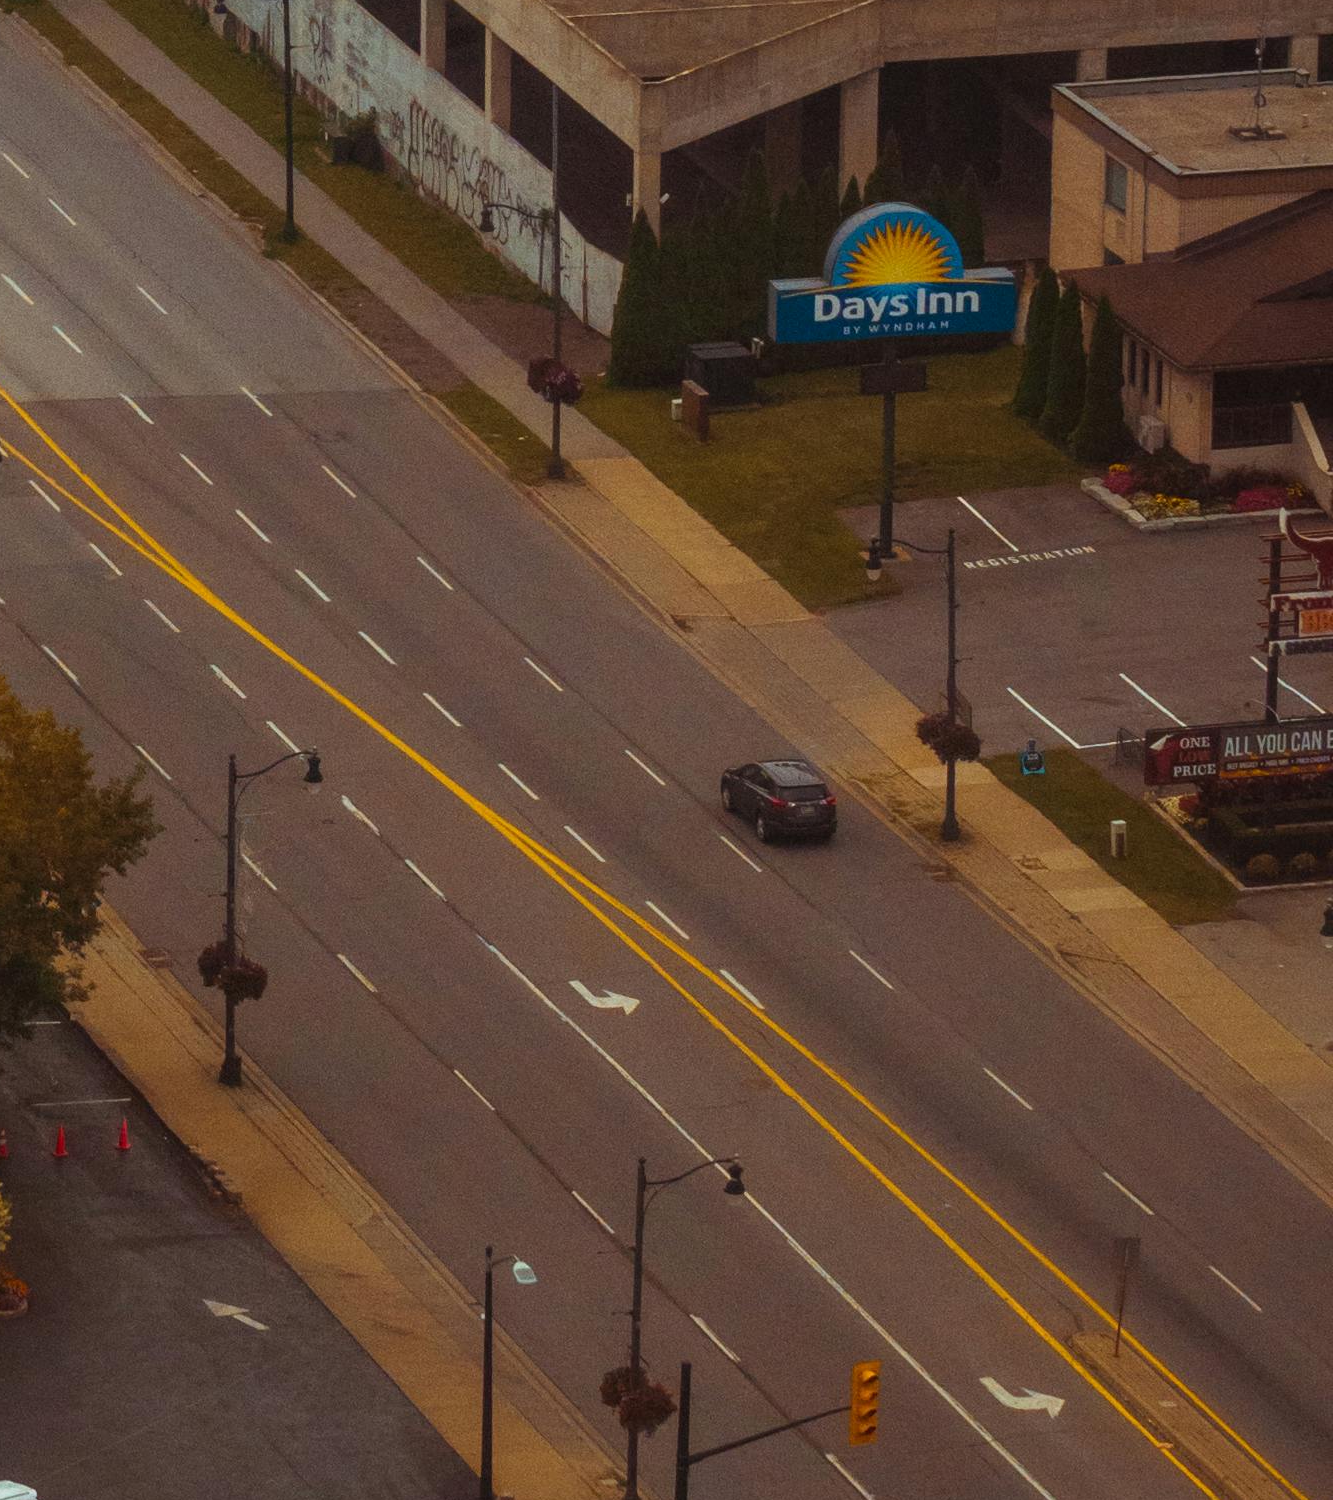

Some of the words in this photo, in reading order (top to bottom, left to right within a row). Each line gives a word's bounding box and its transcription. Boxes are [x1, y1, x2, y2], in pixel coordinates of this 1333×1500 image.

[814, 293, 909, 322] Days
[916, 287, 980, 315] Inn
[843, 326, 860, 335] BY
[868, 320, 950, 333] WYNDHAM
[963, 546, 1096, 569] REGISTRATION
[1179, 736, 1210, 749] ONE
[1224, 736, 1252, 757] ALL
[1256, 733, 1287, 755] YOU
[1290, 730, 1322, 752] CAN
[1173, 763, 1217, 778] PRICE
